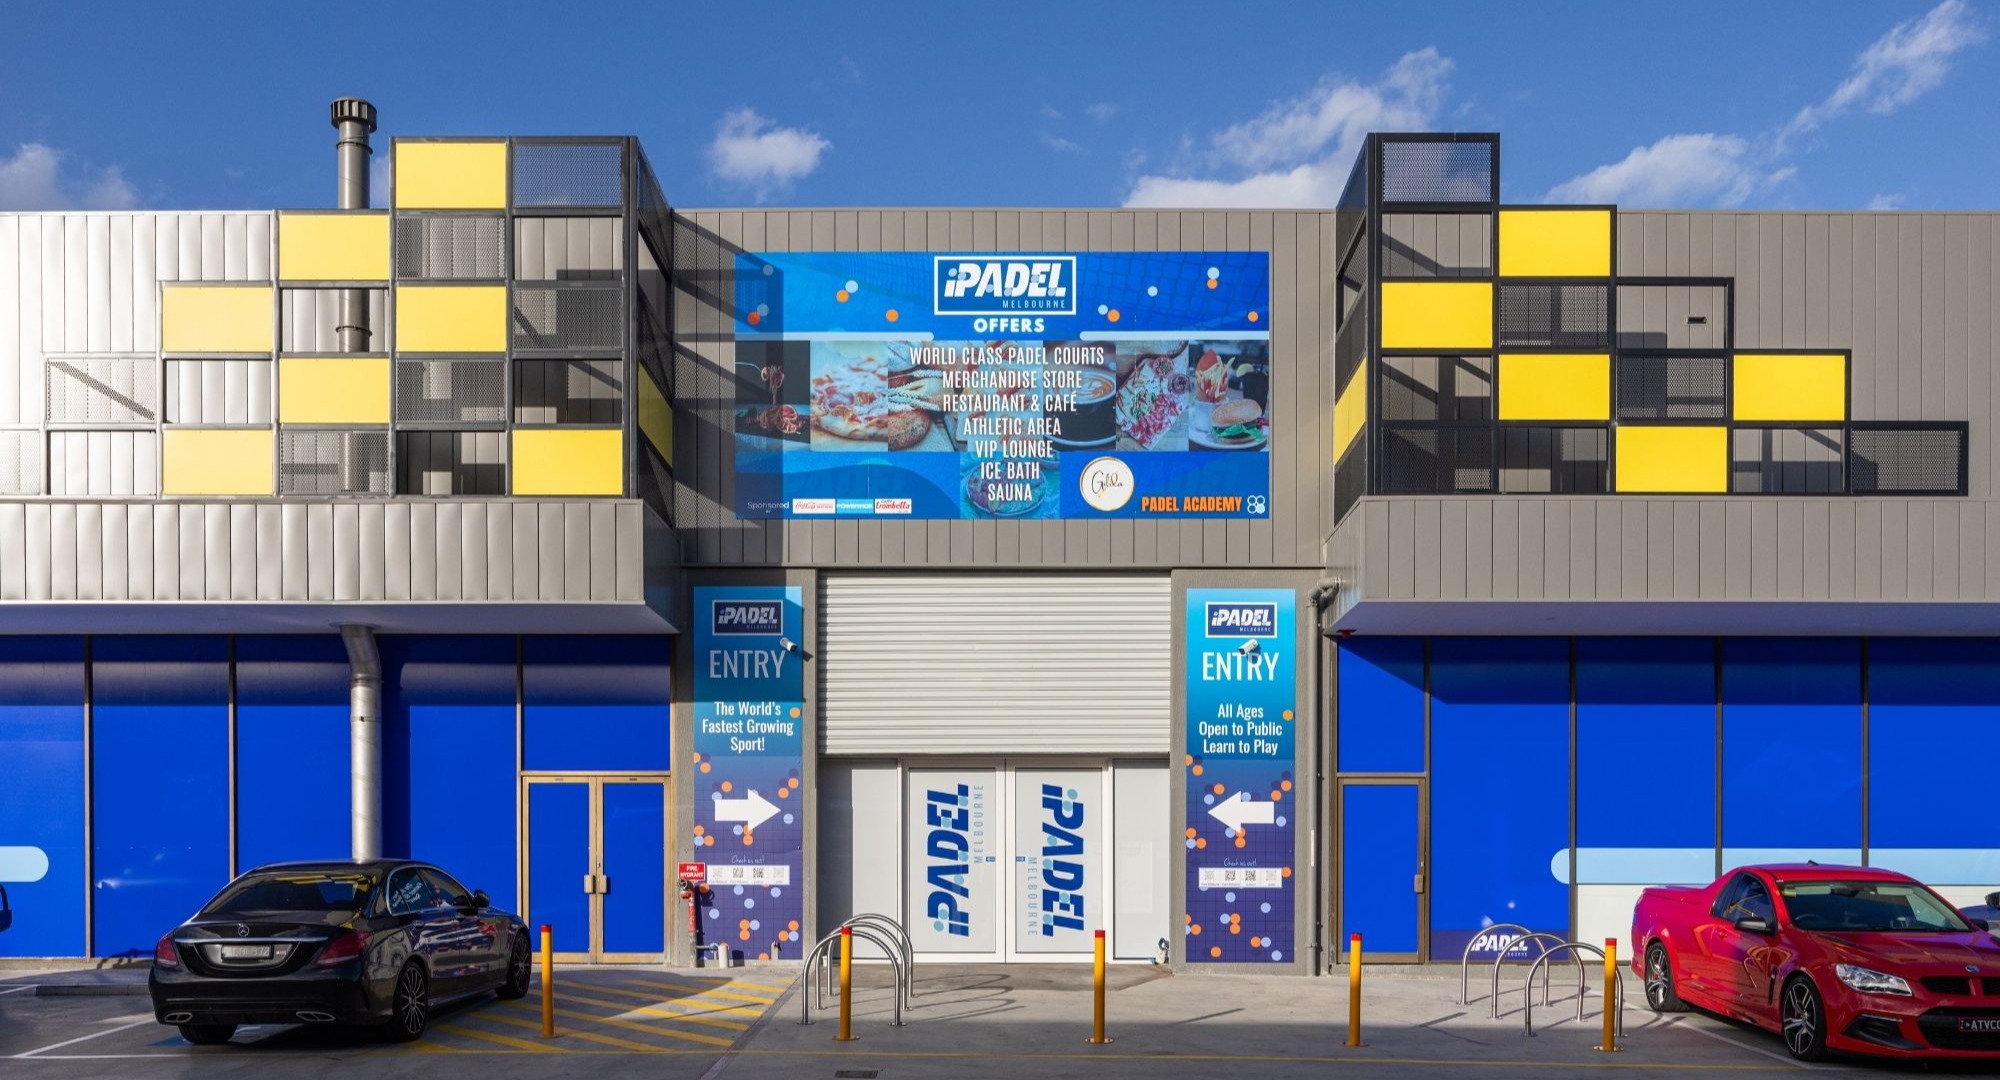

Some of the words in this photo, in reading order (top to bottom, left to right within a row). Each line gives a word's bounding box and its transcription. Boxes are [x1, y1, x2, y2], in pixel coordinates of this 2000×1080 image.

[944, 263, 1067, 297] iPADEL
[1002, 300, 1065, 309] MELBOURNE
[973, 318, 1045, 333] OFFERS
[910, 347, 956, 365] WORLD
[962, 347, 1003, 365] CLASS
[1008, 347, 1048, 365] PADEL
[1054, 347, 1104, 365] COURTS
[942, 370, 1037, 388] MERCHANDISE
[1043, 370, 1082, 388] STORE
[943, 394, 1025, 412] RESTAURANT
[1031, 394, 1040, 412] &
[1045, 390, 1077, 412] CAFÉ
[963, 417, 1022, 435] ATHLETIC
[1028, 417, 1061, 435] AREA
[975, 440, 997, 458] VIP
[1003, 440, 1053, 458] LOUNGE
[981, 462, 1001, 479] ICE
[1007, 462, 1040, 479] BATH
[988, 483, 1032, 501] SAUNA
[747, 501, 790, 510] Sponsored
[1141, 496, 1179, 512] PADEL
[1183, 496, 1242, 512] ACADEMY
[718, 607, 777, 624] iPADEL
[1211, 609, 1271, 626] iPADEL
[709, 650, 786, 679] ENTRY
[1202, 652, 1279, 681] ENTRY
[714, 701, 735, 716] The
[738, 701, 781, 716] World's
[1217, 704, 1233, 718] All
[1236, 704, 1264, 721] Ages
[702, 718, 743, 733] Fastest
[747, 719, 794, 736] Growing
[1199, 721, 1228, 738] Open
[1232, 723, 1243, 736] to
[1247, 721, 1283, 736] Public
[730, 736, 765, 754] Sport!
[1203, 739, 1235, 753] Learn
[1239, 740, 1250, 754] to
[1254, 739, 1278, 755] Play
[973, 785, 984, 864] MELBOURNE
[927, 783, 969, 937] iPADEL
[1042, 783, 1084, 937] iPADEL
[1223, 858, 1238, 866] Check
[1028, 856, 1038, 936] MELBOURNE
